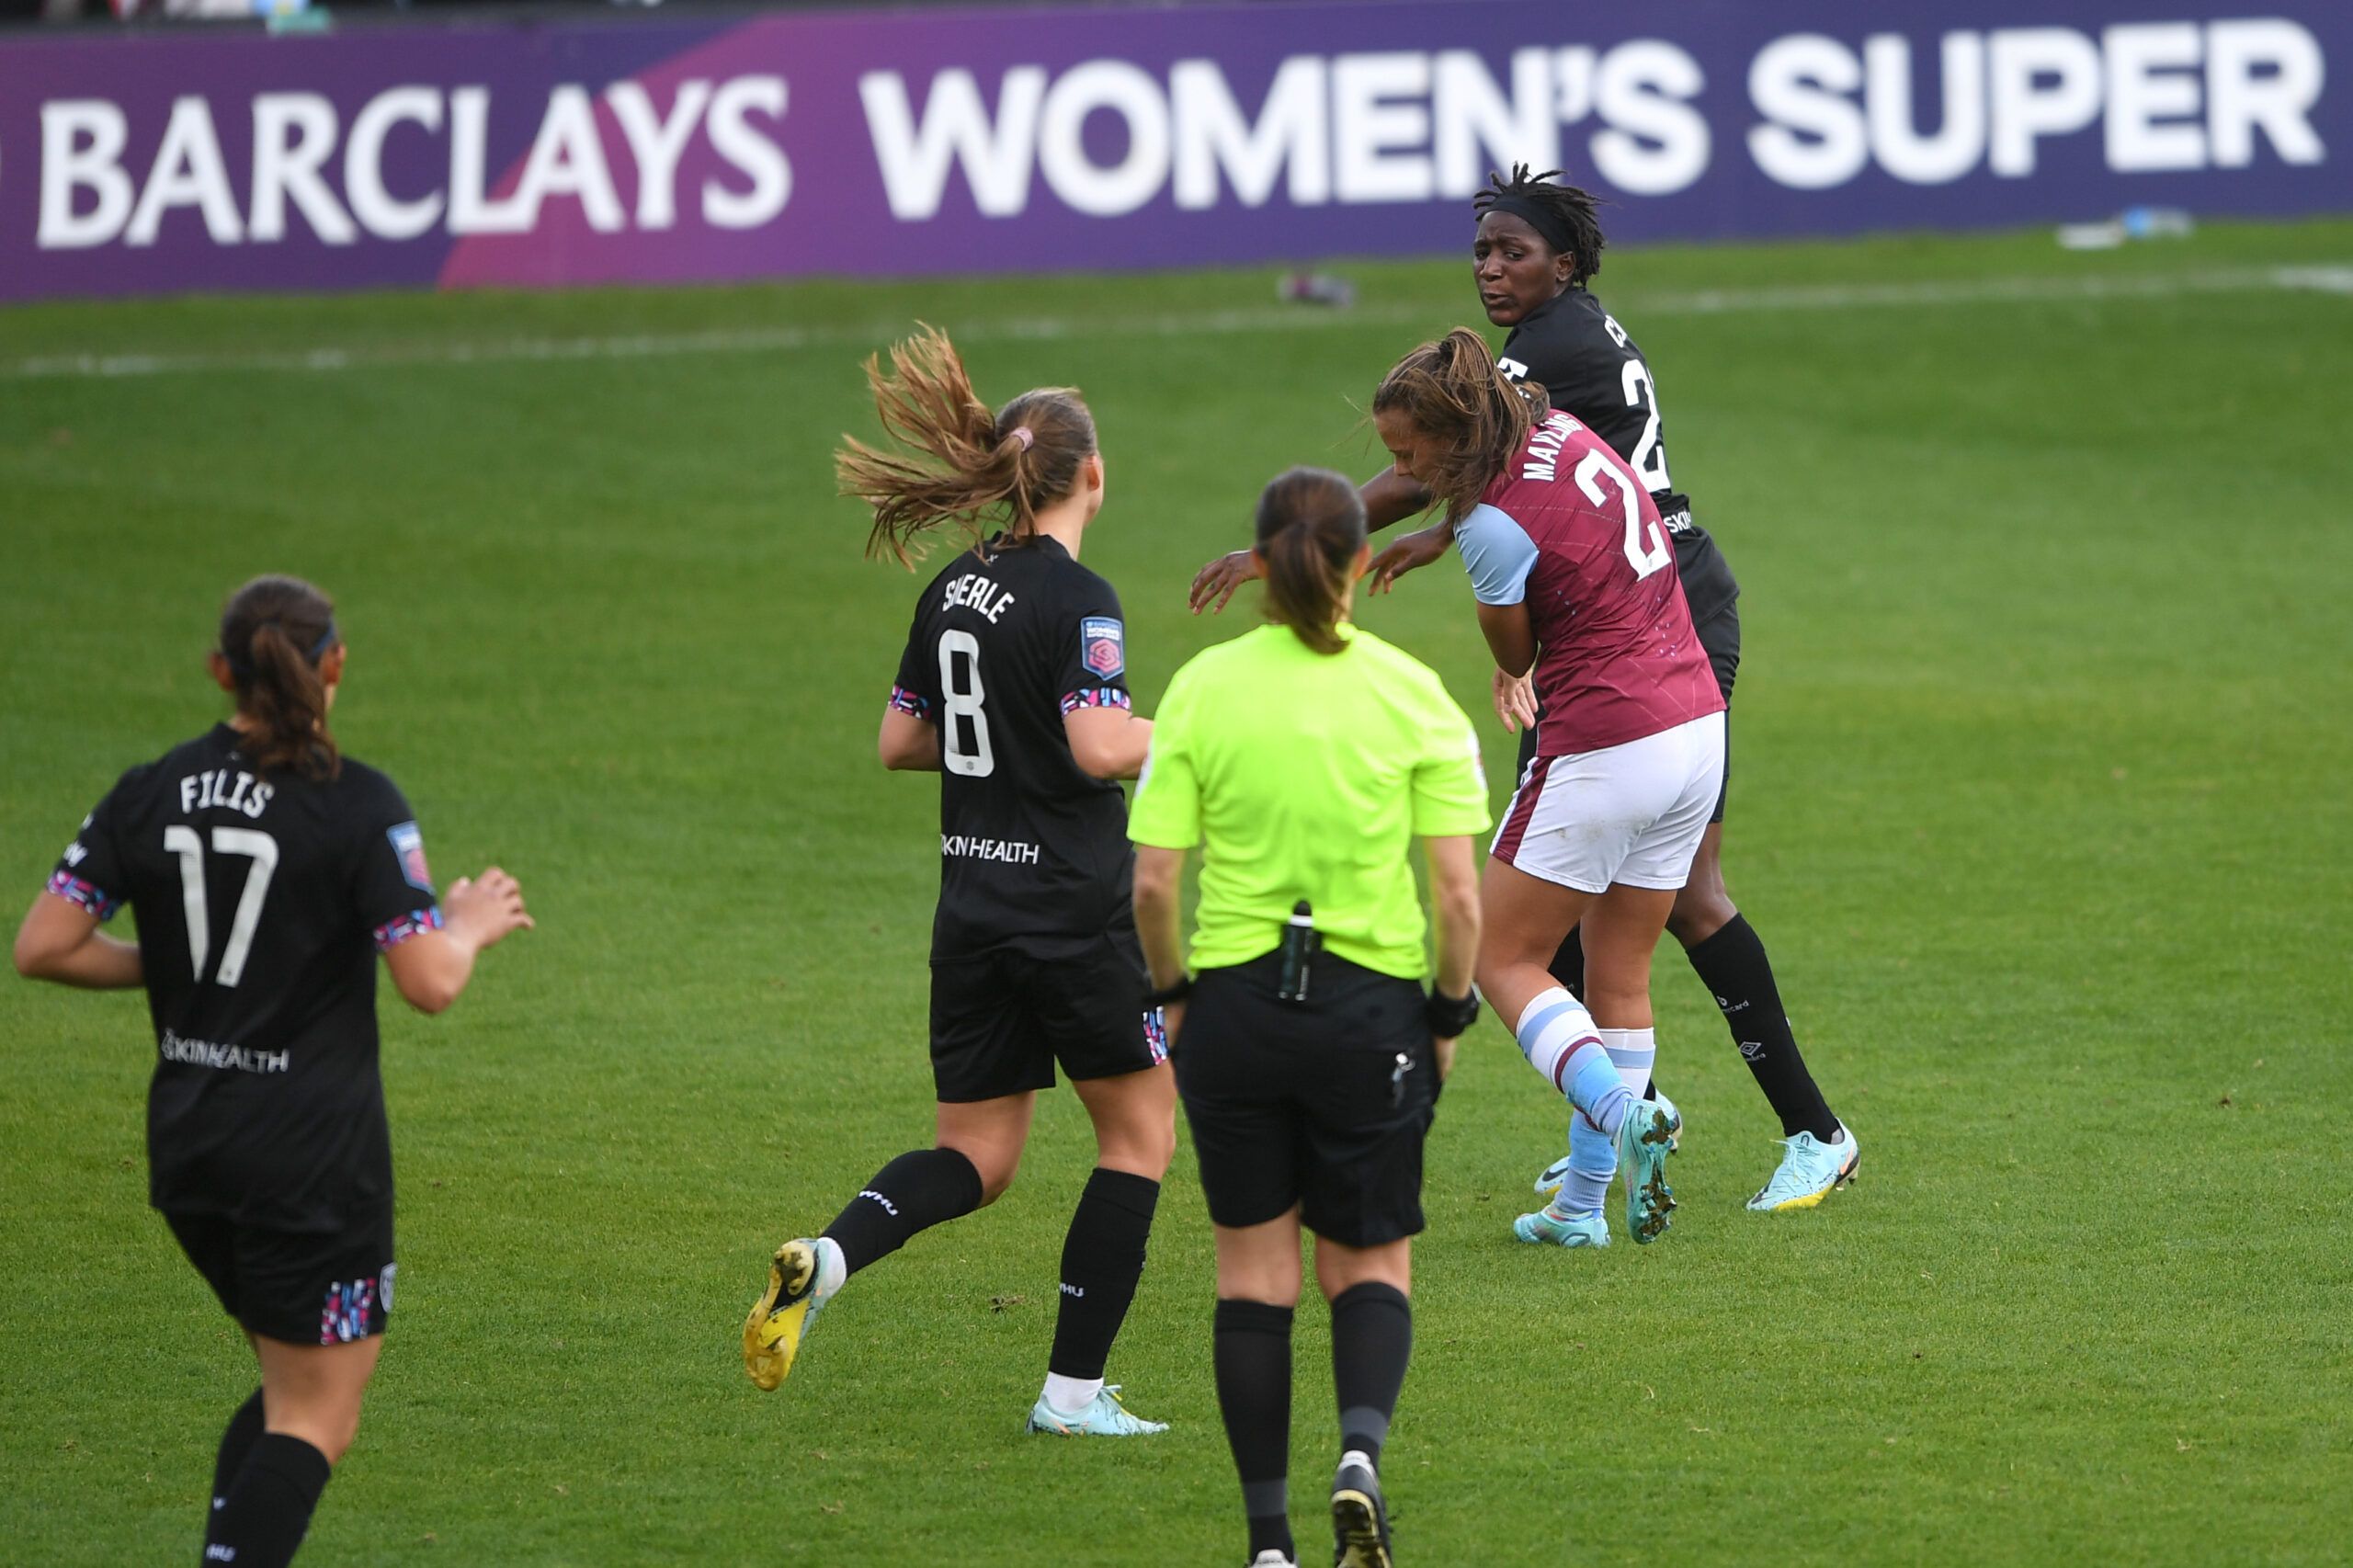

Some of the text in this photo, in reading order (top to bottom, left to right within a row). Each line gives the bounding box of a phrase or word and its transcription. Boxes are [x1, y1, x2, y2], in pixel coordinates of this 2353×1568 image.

[39, 18, 2325, 247] BARCLAYS WOMEN'S SUPER
[1574, 448, 1672, 582] 2
[938, 628, 995, 778] 8
[180, 768, 275, 819] FILIS
[164, 825, 279, 988] 17
[858, 1190, 898, 1216] WHU
